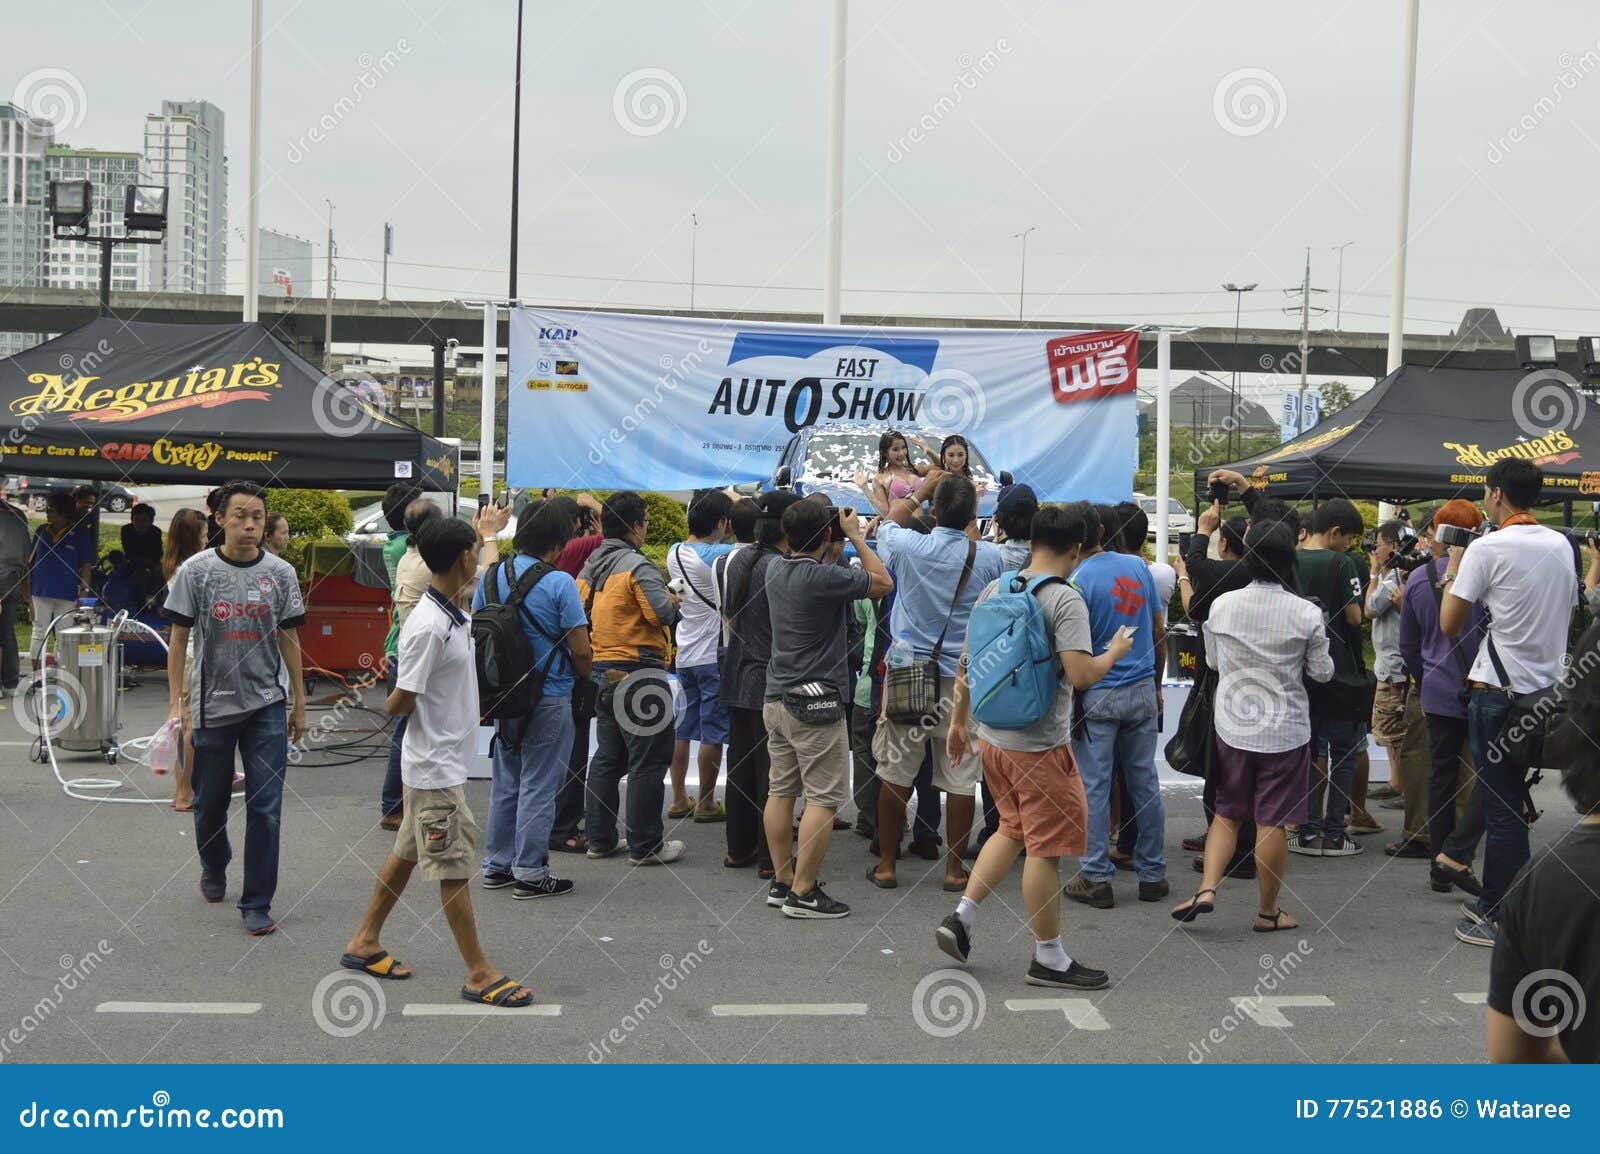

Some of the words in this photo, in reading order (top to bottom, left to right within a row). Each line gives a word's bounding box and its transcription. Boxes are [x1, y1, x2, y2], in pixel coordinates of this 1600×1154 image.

[539, 328, 578, 340] KAP
[836, 358, 879, 378] FAST
[1057, 344, 1129, 393] ฟรี
[9, 356, 280, 421] Meguiar's
[708, 377, 823, 433] AUTO
[827, 382, 927, 421] SHOW
[22, 445, 43, 455] Car
[47, 445, 75, 456] Care
[79, 446, 97, 456] for
[102, 442, 150, 460] CAR
[152, 438, 222, 471] Crazy
[1451, 474, 1487, 484] SERIO
[1557, 479, 1578, 487] FOR
[1350, 577, 1361, 596] 3
[807, 700, 837, 710] adidas
